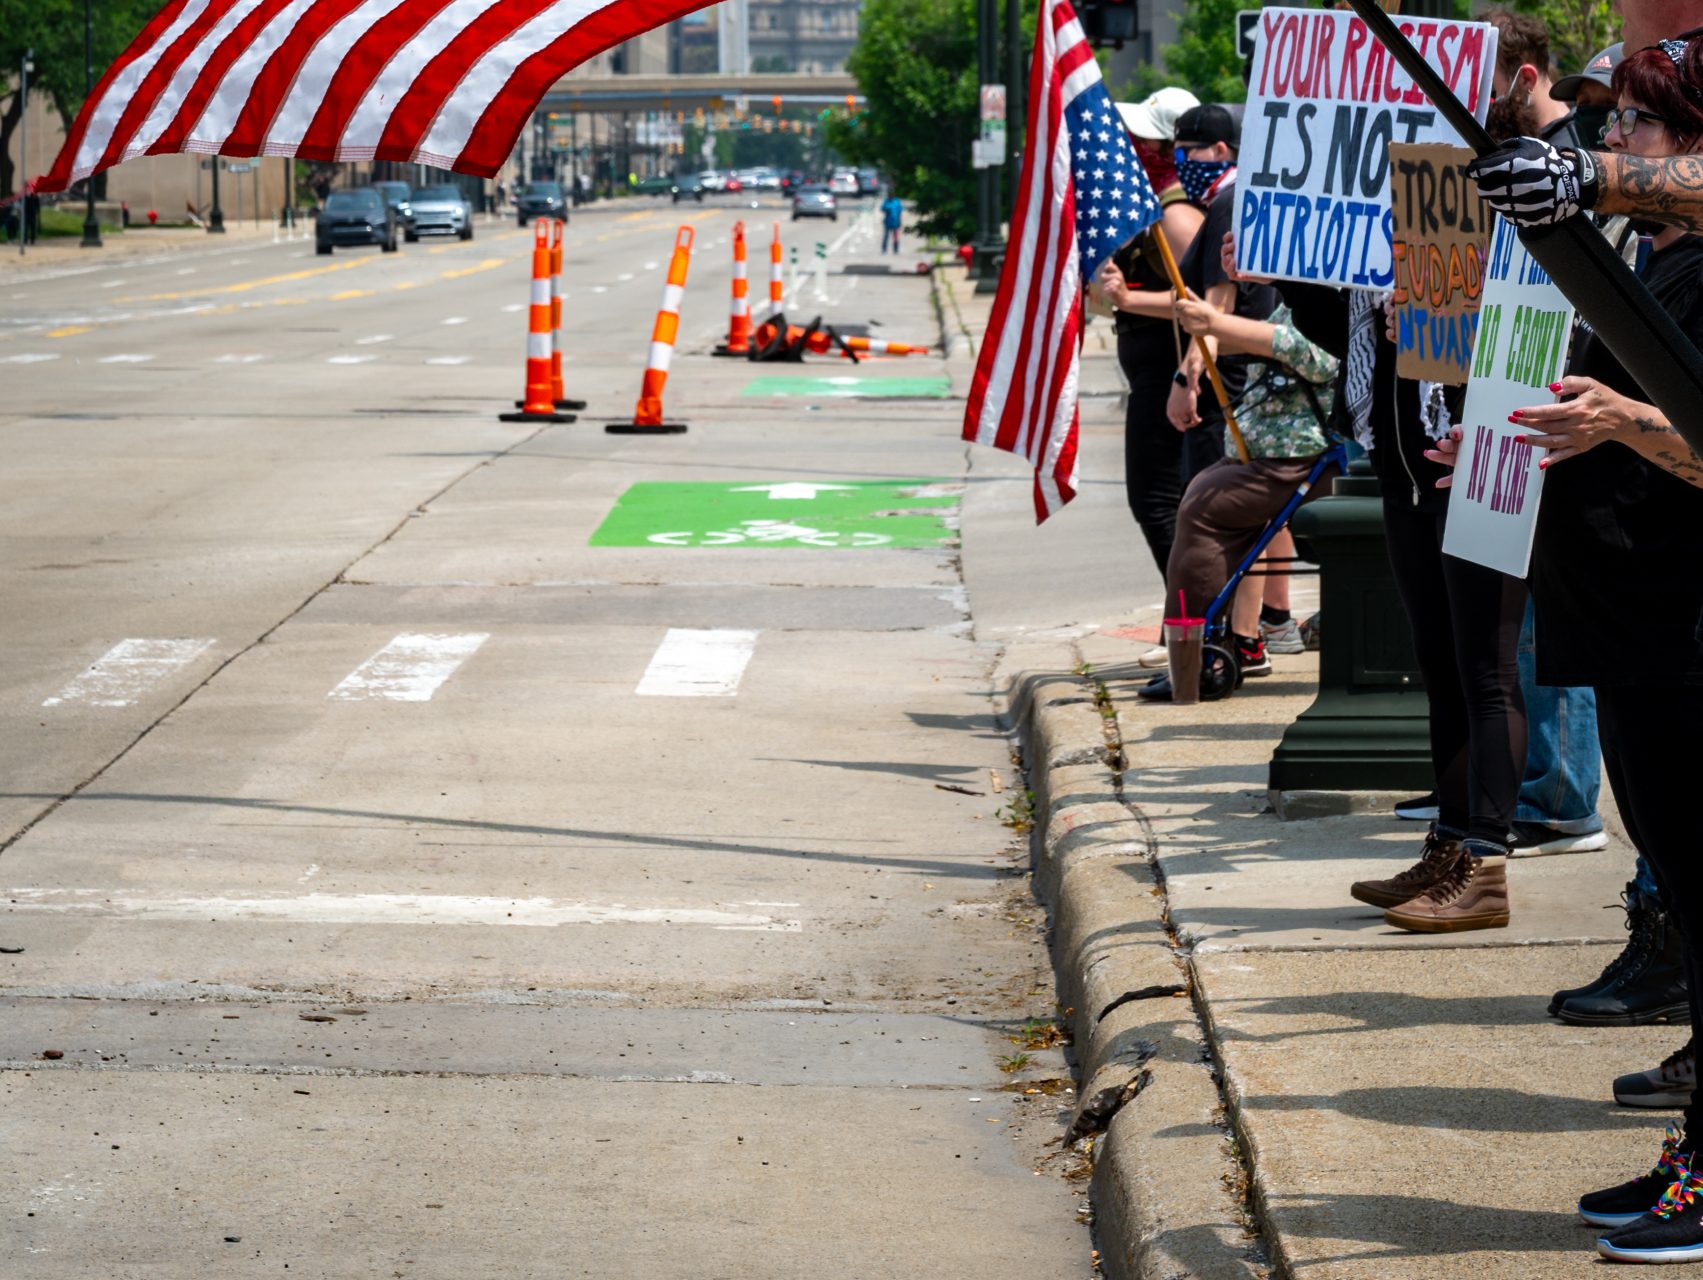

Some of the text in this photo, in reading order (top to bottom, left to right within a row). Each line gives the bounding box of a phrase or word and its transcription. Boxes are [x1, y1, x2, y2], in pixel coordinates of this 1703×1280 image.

[1258, 11, 1336, 99] YOUR
[1250, 101, 1318, 191] IS
[1473, 304, 1567, 388] NO CROWN
[1466, 425, 1533, 515] NO KING
